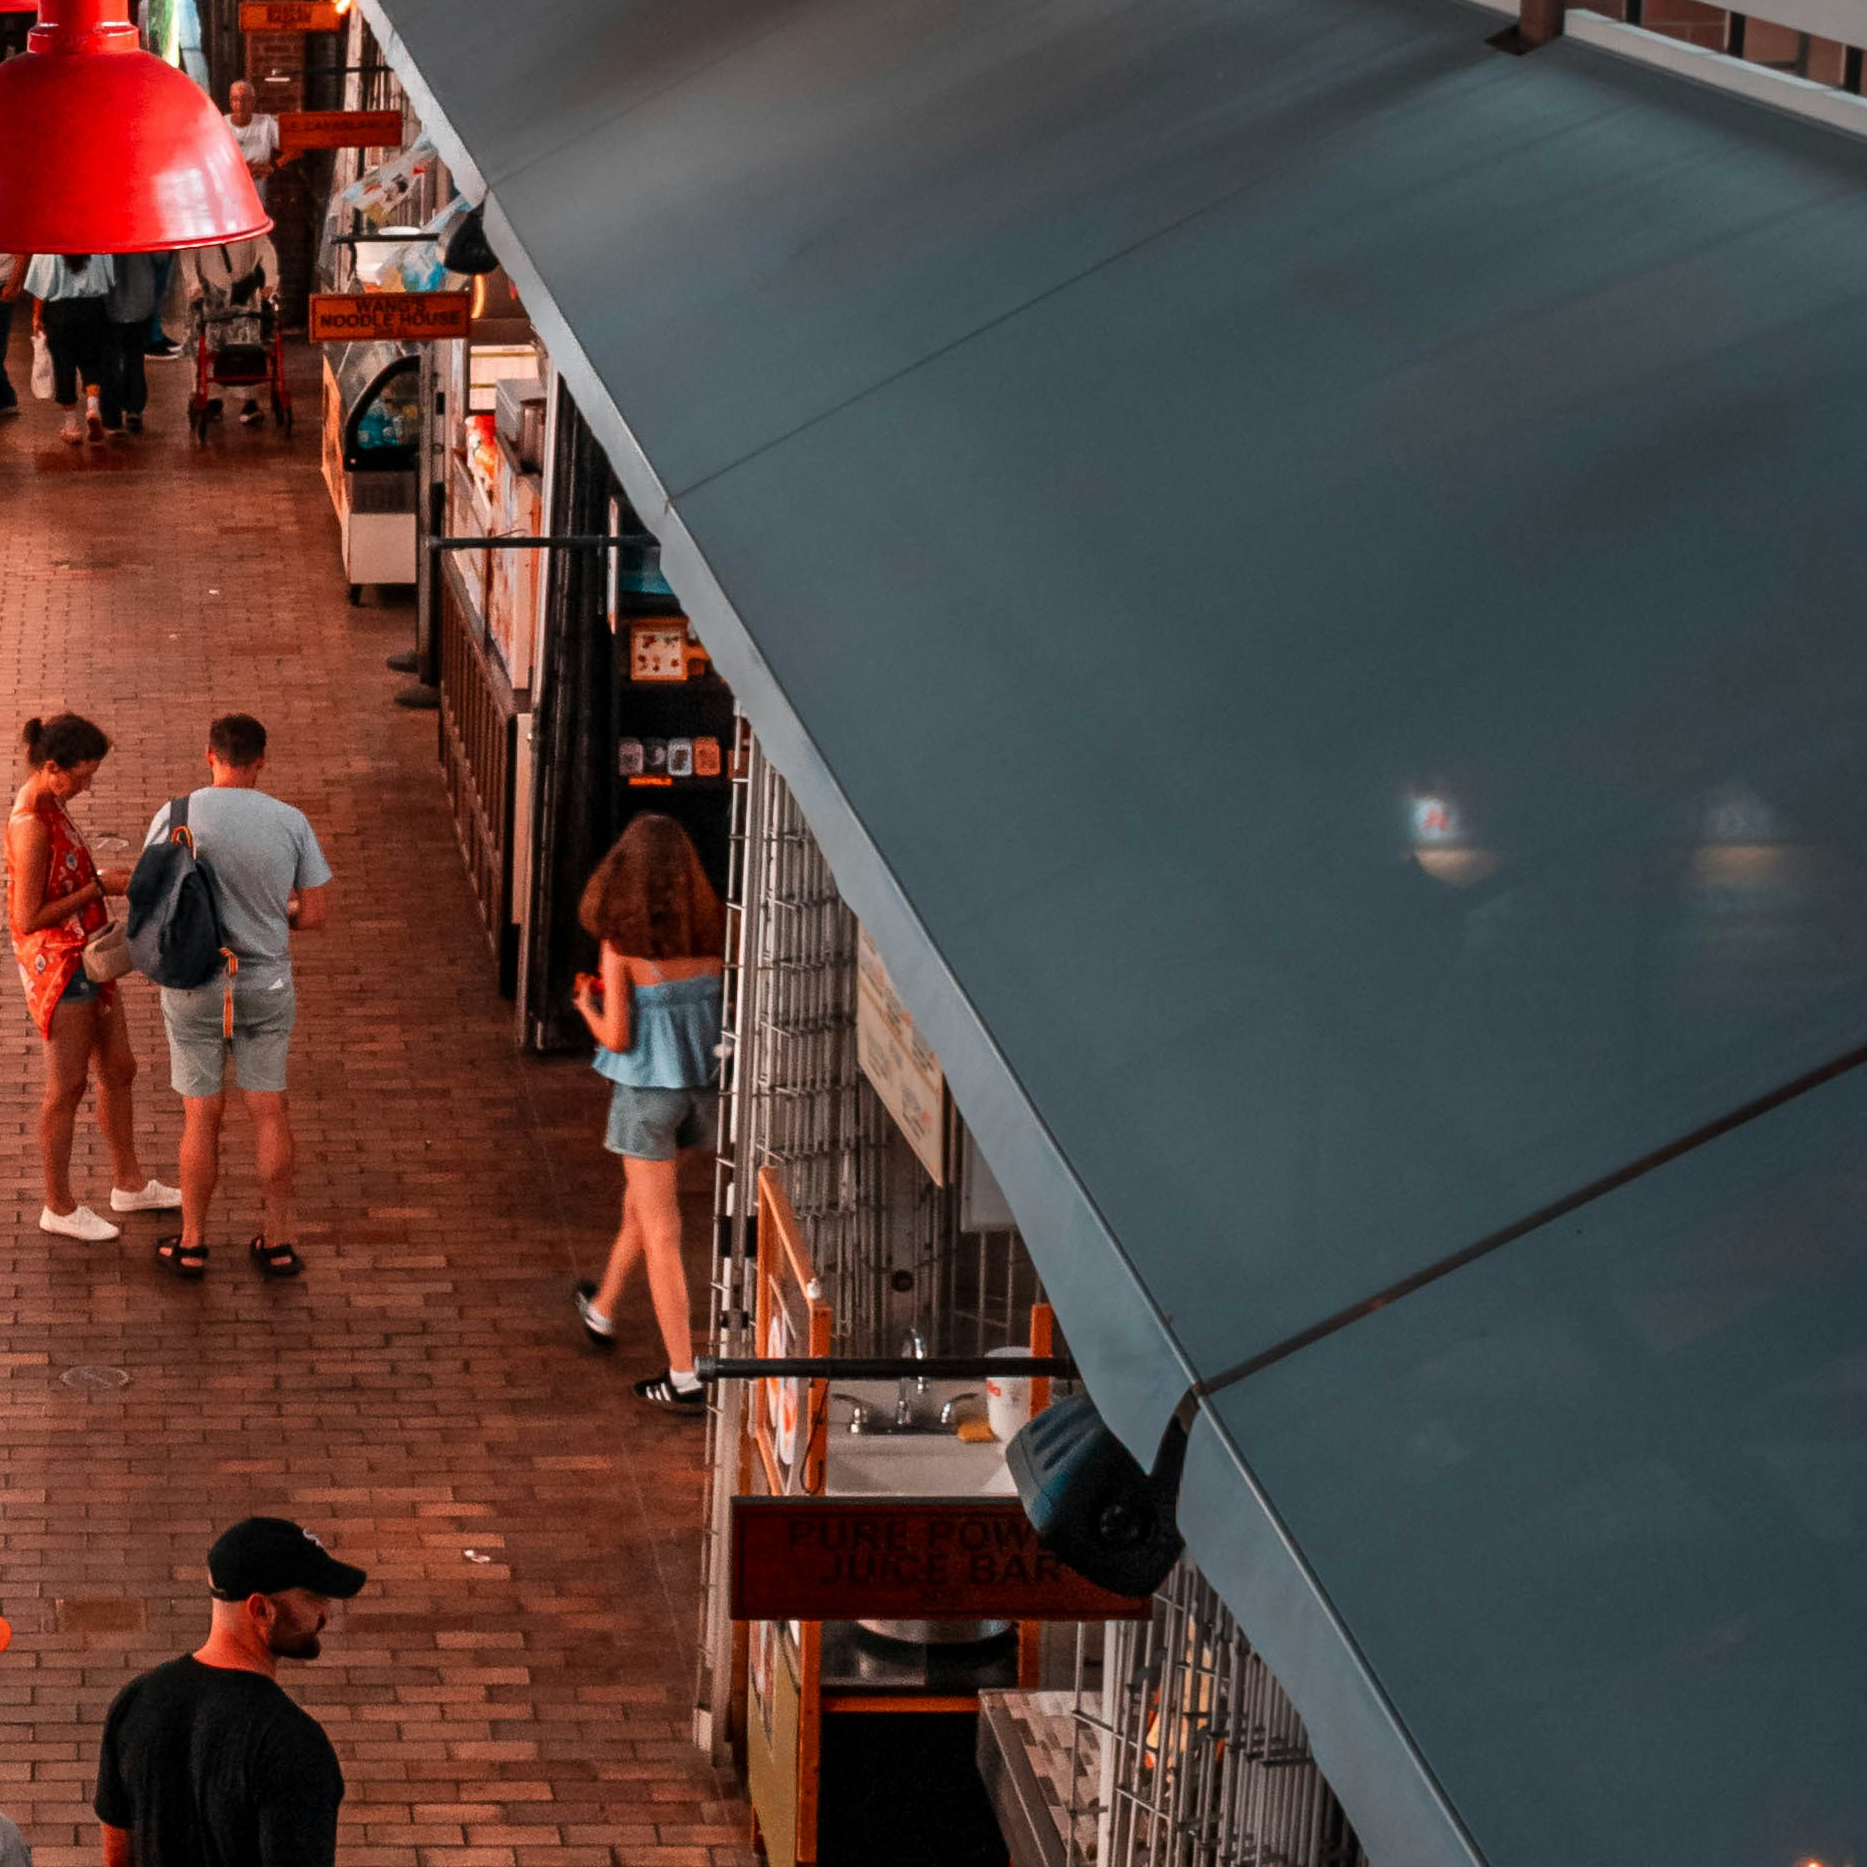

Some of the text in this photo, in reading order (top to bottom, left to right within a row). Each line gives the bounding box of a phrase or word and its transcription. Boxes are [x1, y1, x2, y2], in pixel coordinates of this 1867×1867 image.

[321, 310, 461, 327] NOODLE HOUSE
[788, 1520, 1043, 1552] PURE POW
[820, 1553, 1062, 1586] JUICE BAR
